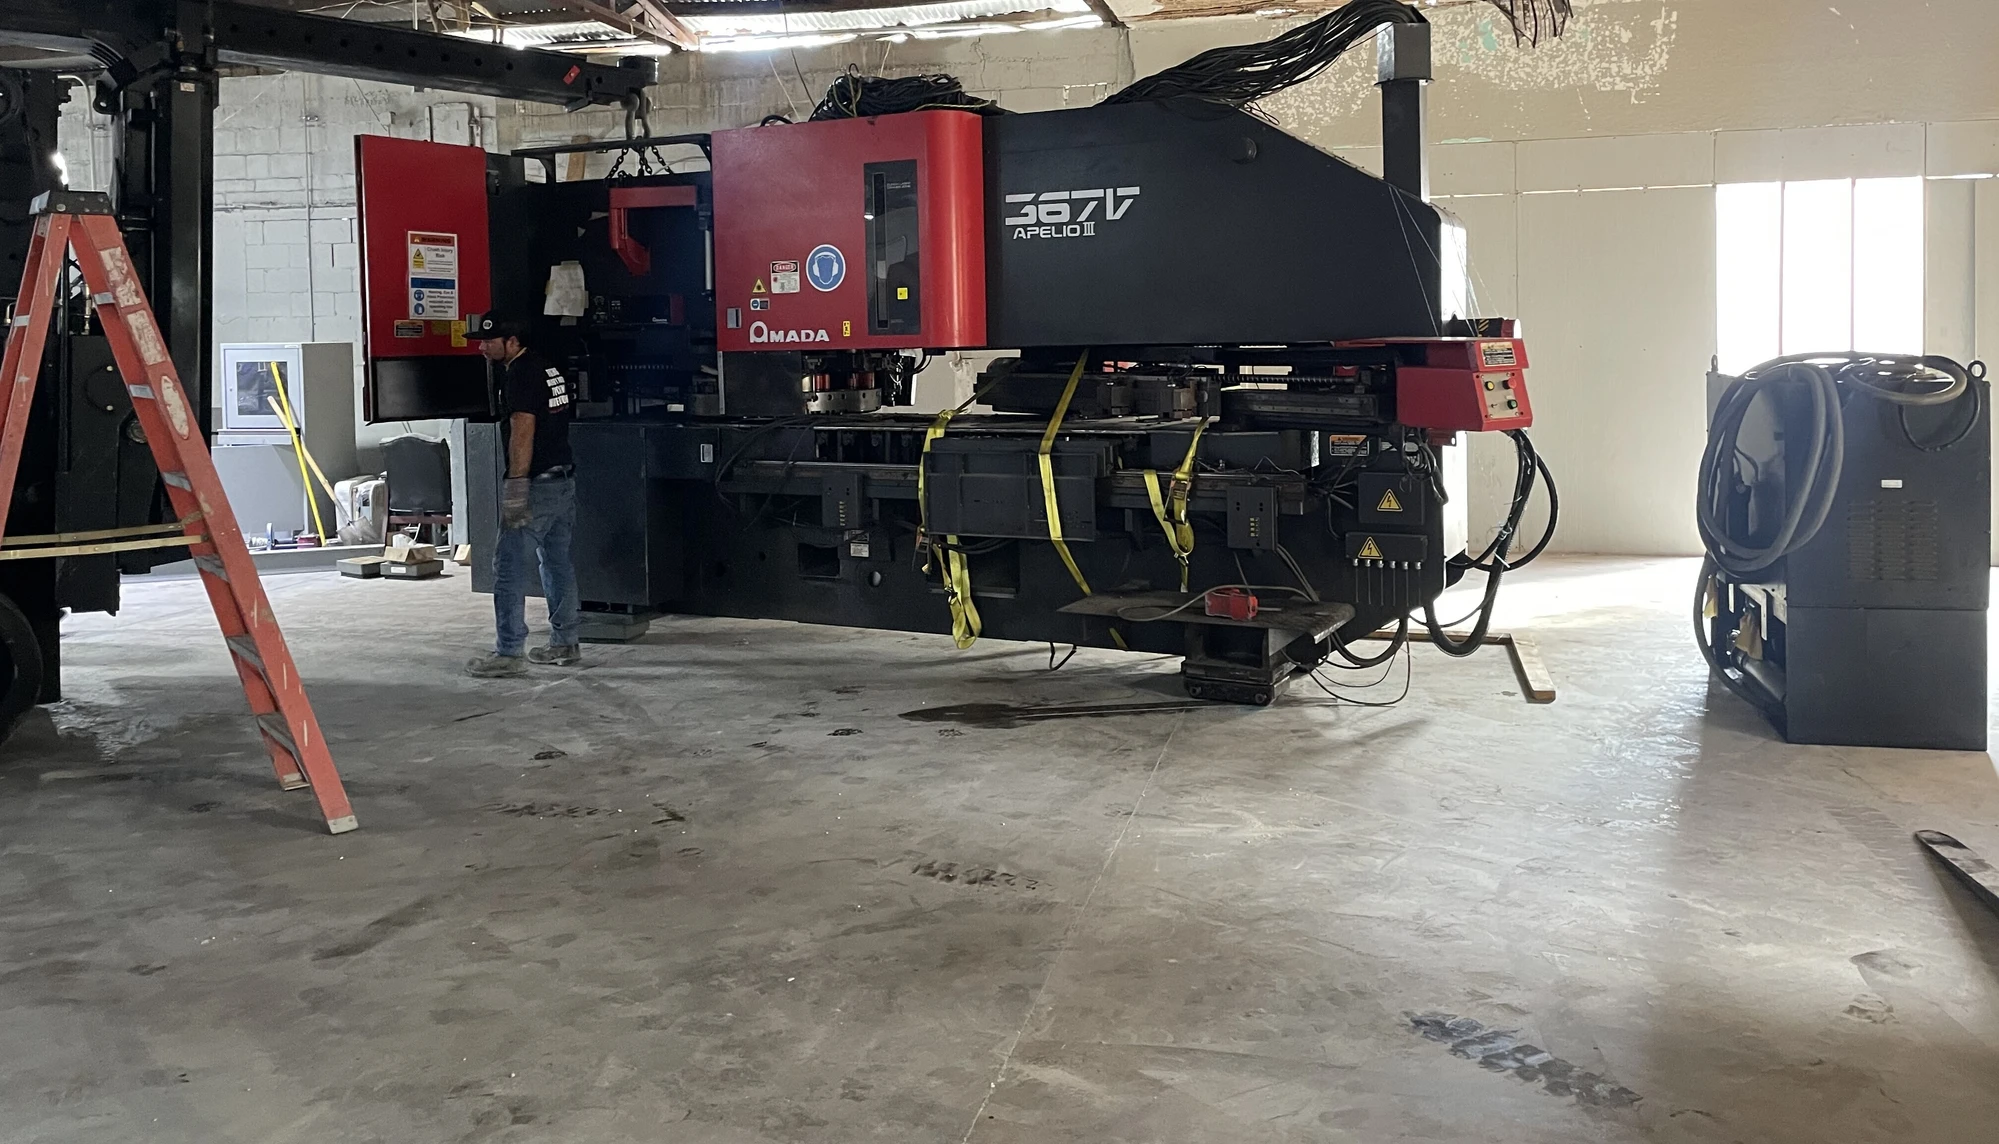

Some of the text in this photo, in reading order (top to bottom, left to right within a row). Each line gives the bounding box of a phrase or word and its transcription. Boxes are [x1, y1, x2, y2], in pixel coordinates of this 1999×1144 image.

[1005, 186, 1140, 226] 367V
[1013, 224, 1080, 239] APELIO
[749, 320, 830, 343] AMADA
